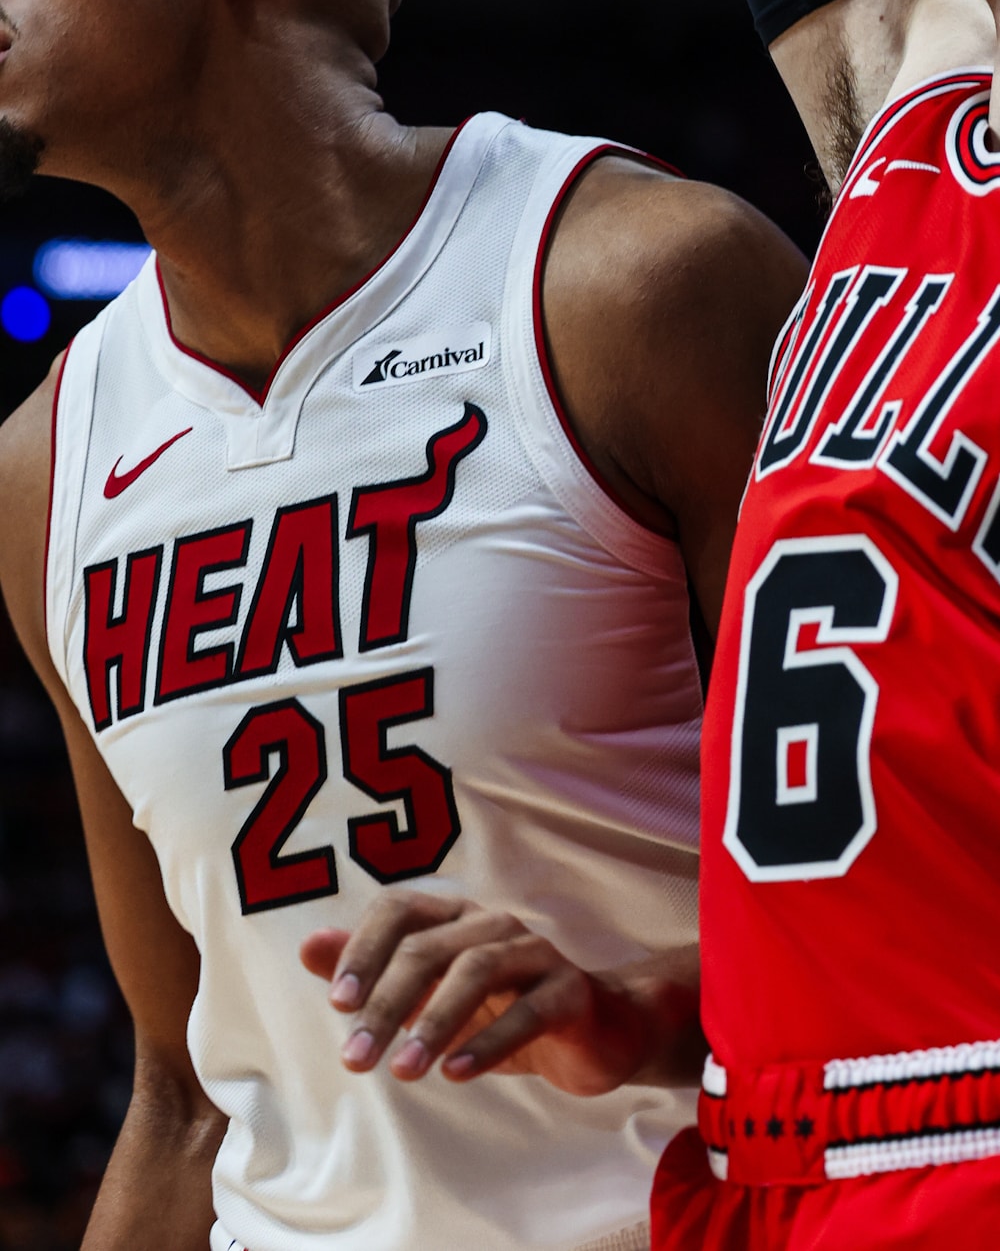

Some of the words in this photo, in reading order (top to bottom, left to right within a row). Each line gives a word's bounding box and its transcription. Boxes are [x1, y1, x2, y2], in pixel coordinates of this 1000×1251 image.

[390, 342, 484, 379] Carnival
[84, 402, 487, 733] HEAT
[722, 534, 899, 883] 6
[224, 667, 461, 915] 25
